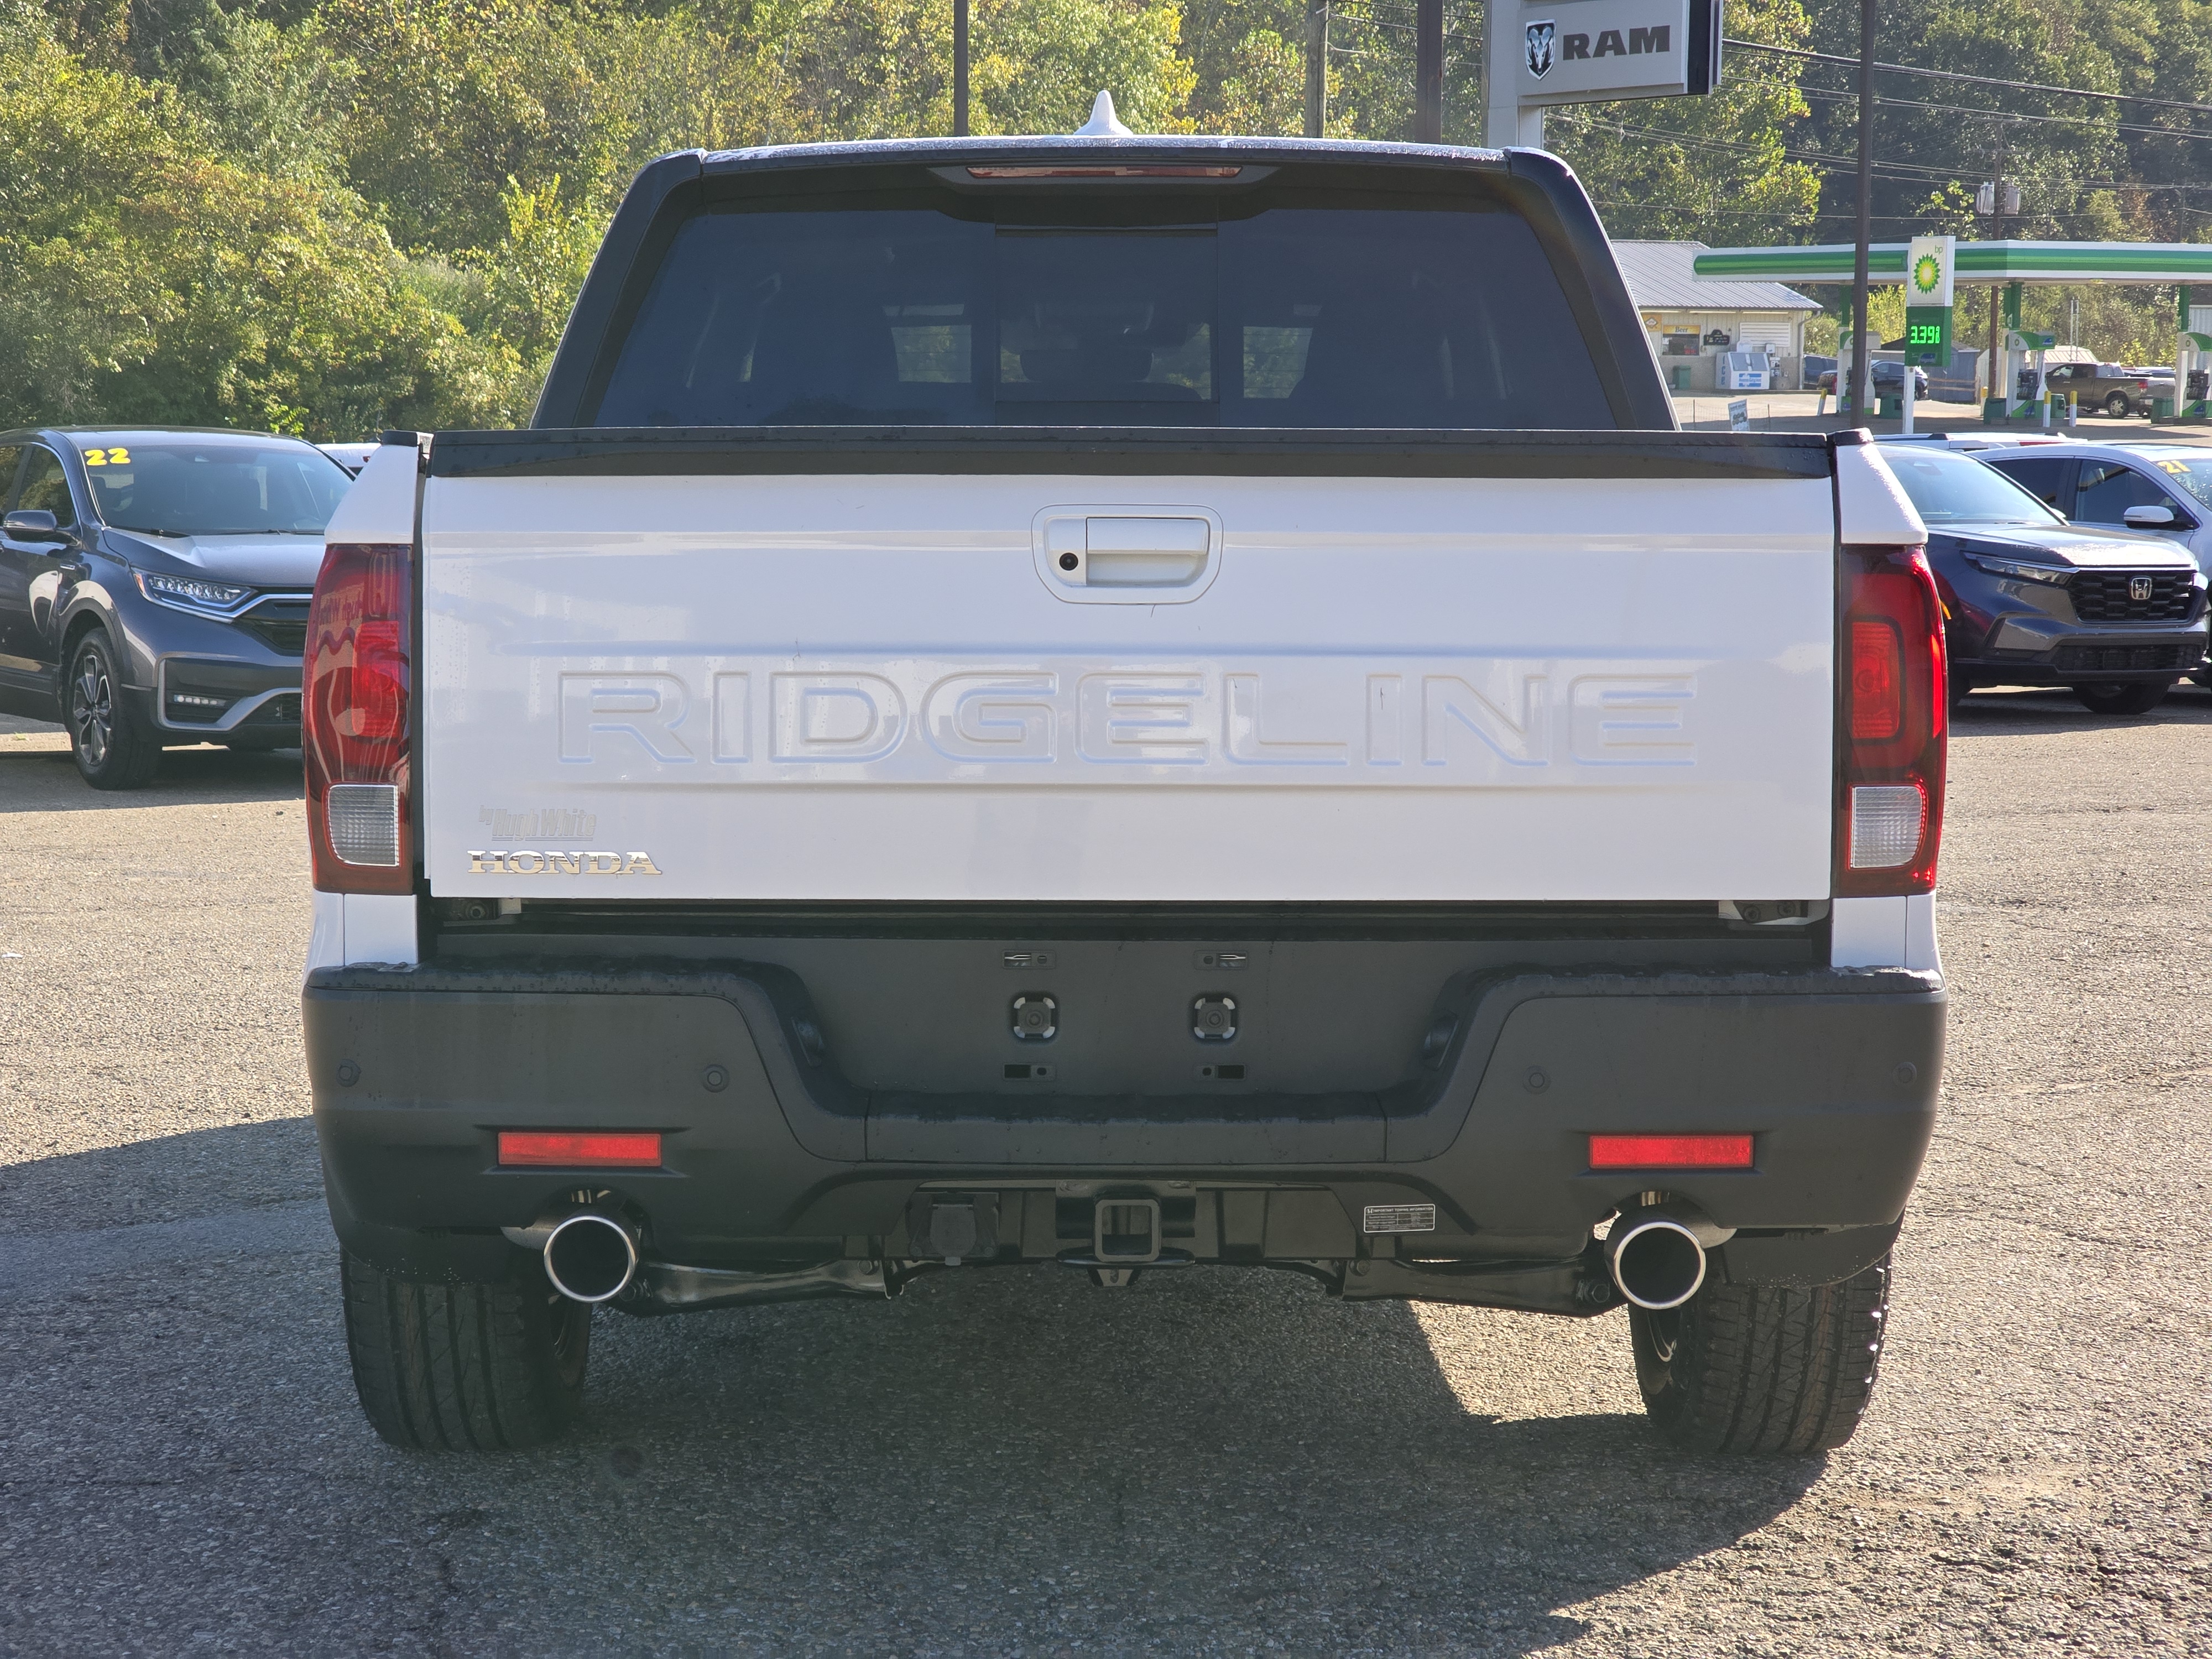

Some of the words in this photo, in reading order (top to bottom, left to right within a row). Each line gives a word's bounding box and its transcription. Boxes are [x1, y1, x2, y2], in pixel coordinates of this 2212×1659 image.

[1563, 25, 1670, 60] RAM
[1934, 245, 1943, 254] bp
[85, 448, 131, 466] 22
[2157, 460, 2192, 473] 21
[557, 670, 1696, 766] RIDGELINE
[492, 808, 539, 841] Hugh
[540, 808, 597, 836] White
[467, 849, 662, 875] HONDA
